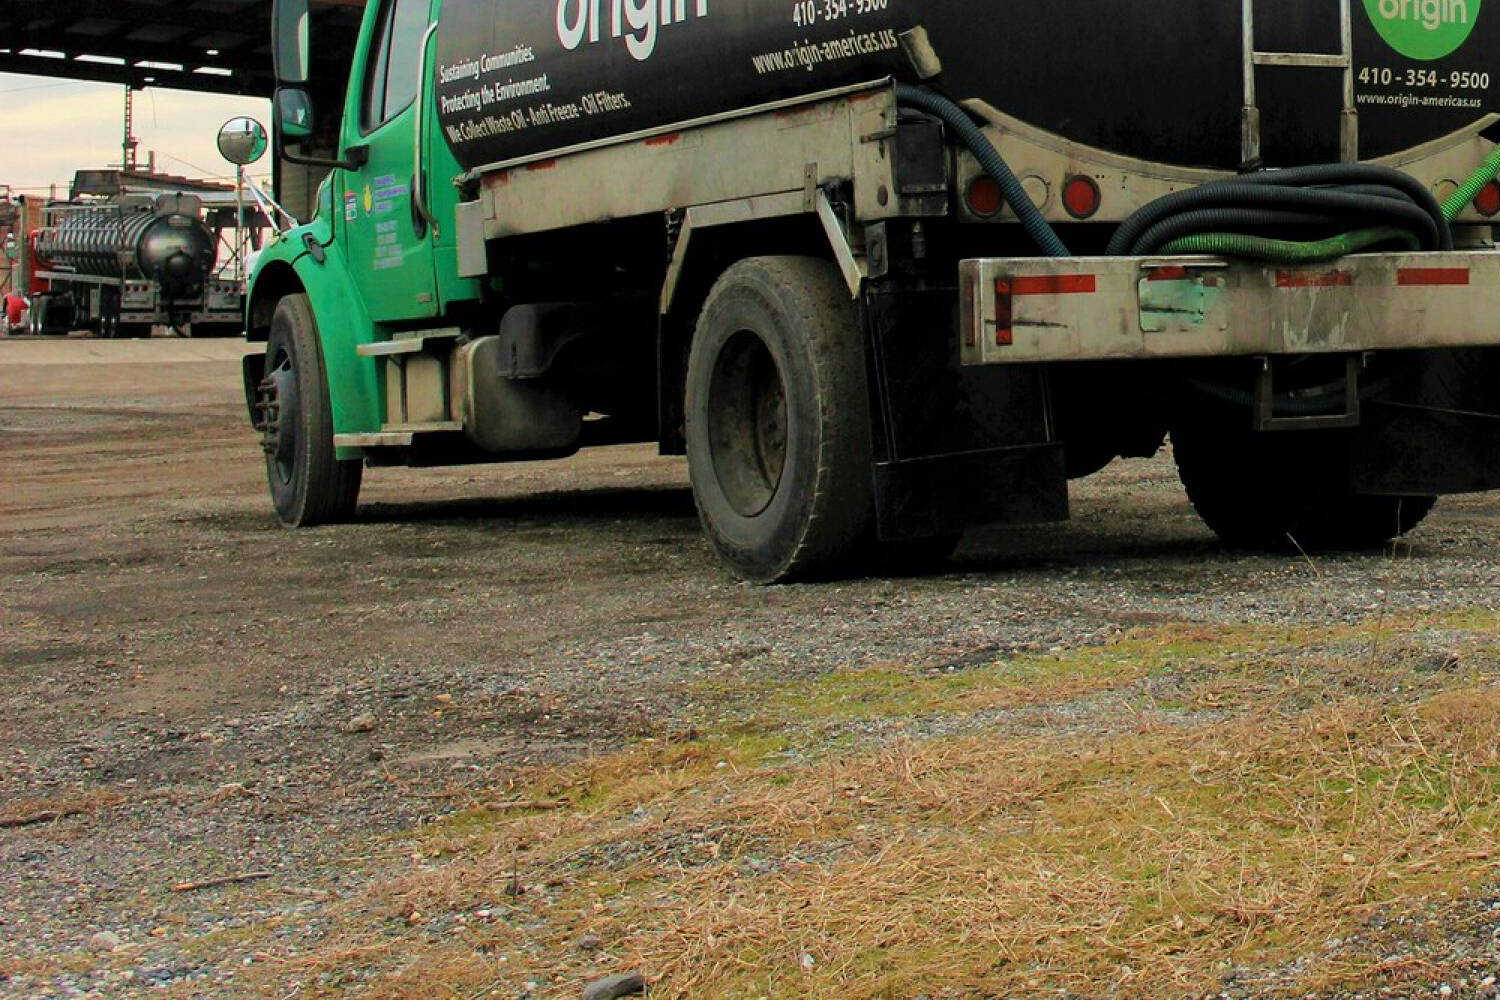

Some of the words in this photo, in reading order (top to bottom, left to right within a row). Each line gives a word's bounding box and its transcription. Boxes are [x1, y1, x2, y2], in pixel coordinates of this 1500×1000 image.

[440, 58, 480, 83] Sustaining
[481, 44, 535, 74] Communities.
[440, 90, 481, 114] Protecting
[481, 85, 494, 104] the
[495, 73, 550, 101] Environment.
[1357, 93, 1481, 108] www.origin-americas.us
[446, 124, 463, 143] We
[463, 119, 487, 142] Collect
[488, 115, 513, 135] Waste
[511, 109, 526, 128] Oil
[529, 103, 549, 126] Anti
[550, 102, 580, 121] Freeze
[581, 93, 598, 116] Oil
[598, 90, 632, 113] Filters.
